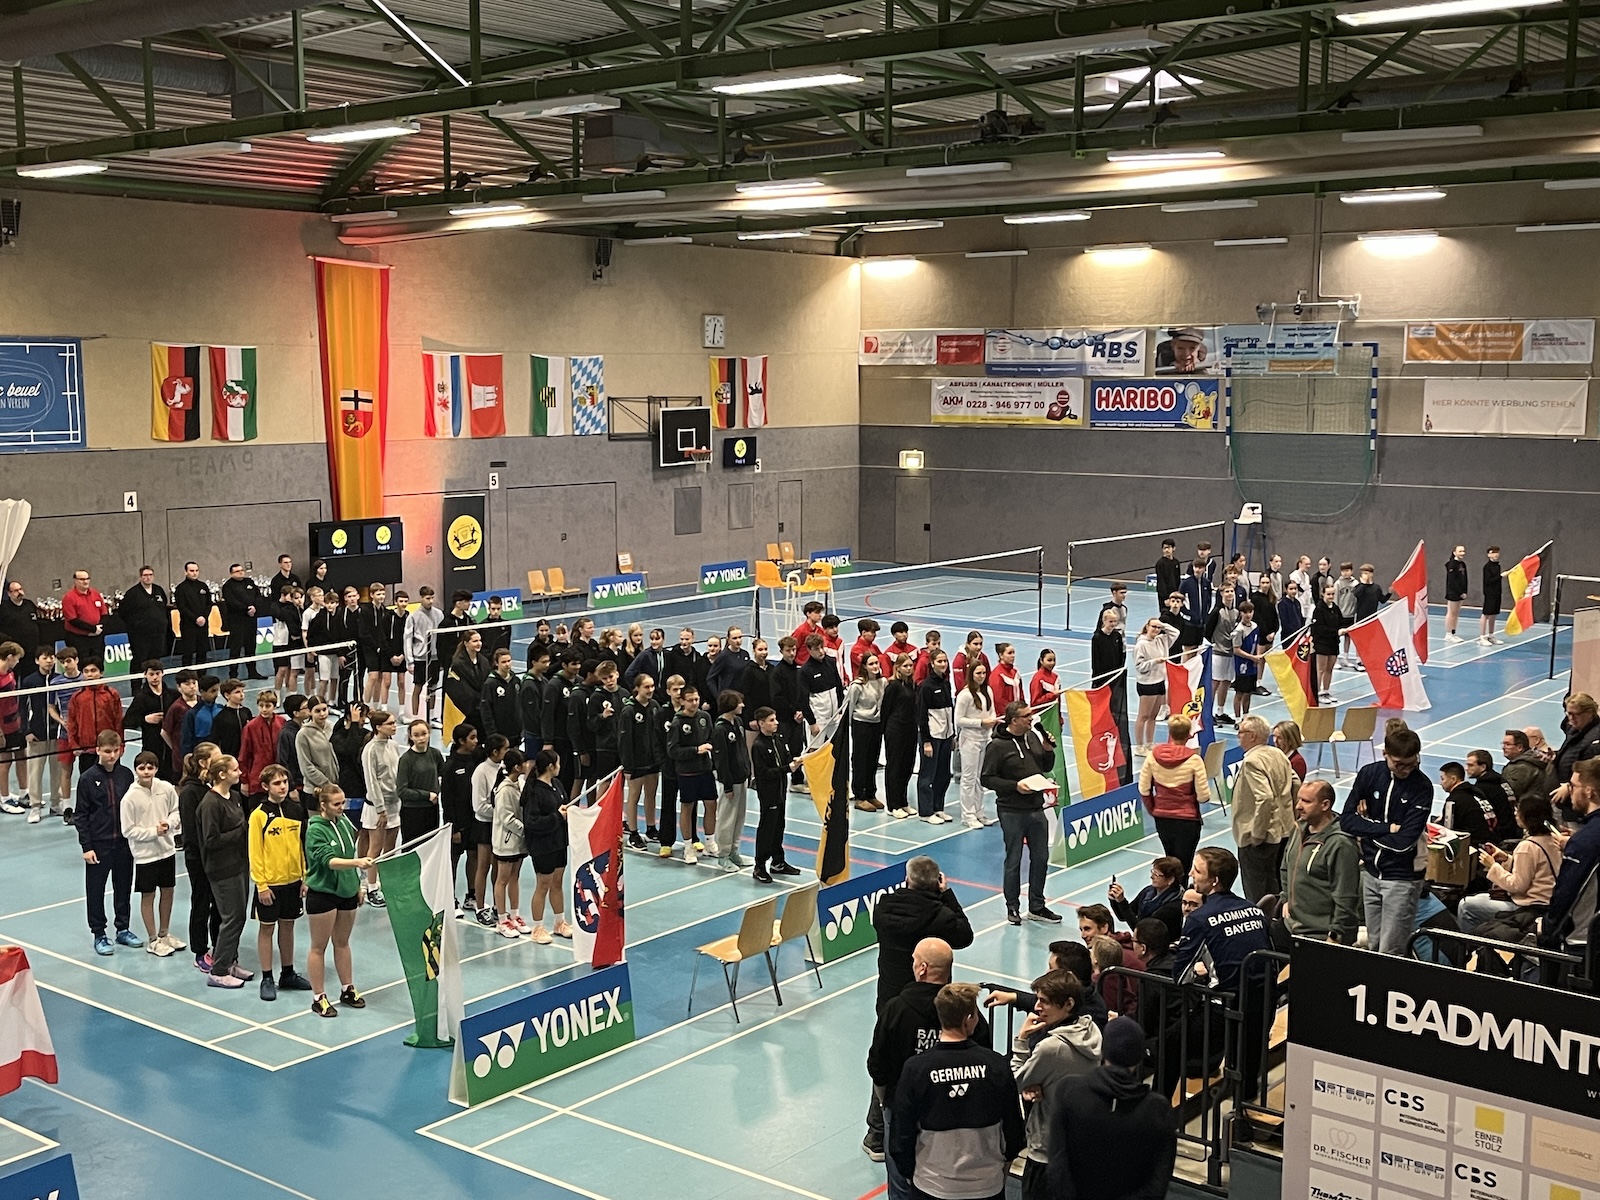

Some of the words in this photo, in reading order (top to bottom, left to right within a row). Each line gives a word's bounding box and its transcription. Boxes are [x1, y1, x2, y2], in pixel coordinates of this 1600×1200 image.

[1092, 341, 1138, 358] RBS
[7, 382, 42, 398] beuel
[1037, 380, 1065, 388] MÜLLER
[942, 396, 963, 406] AKM
[966, 401, 987, 409] 0228
[996, 401, 1012, 409] 946
[1096, 388, 1176, 410] HARIBO
[1432, 399, 1451, 407] HIER
[1454, 398, 1490, 407] KÖNNTE
[1492, 399, 1539, 408] WERBUNG
[491, 475, 497, 486] 5
[127, 495, 134, 507] 4
[719, 566, 747, 582] YONEX
[612, 580, 643, 597] YONEX
[104, 642, 133, 664] ONE
[1094, 798, 1139, 839] YONEX
[1224, 919, 1264, 937] BAYERN
[531, 986, 624, 1054] YONEX
[917, 1028, 941, 1040] BA
[1347, 983, 1378, 1026] 1.
[1386, 990, 1600, 1076] BADMINT
[929, 1064, 987, 1084] GERMANY
[1327, 1082, 1375, 1100] STEEP
[1384, 1088, 1425, 1112] CBS
[1474, 1130, 1503, 1145] EBNER
[1313, 1143, 1329, 1155] DR.
[1331, 1148, 1372, 1167] FISCHER
[1474, 1139, 1503, 1154] STOLZ
[1394, 1155, 1445, 1174] STEEP
[1454, 1163, 1497, 1188] CBS
